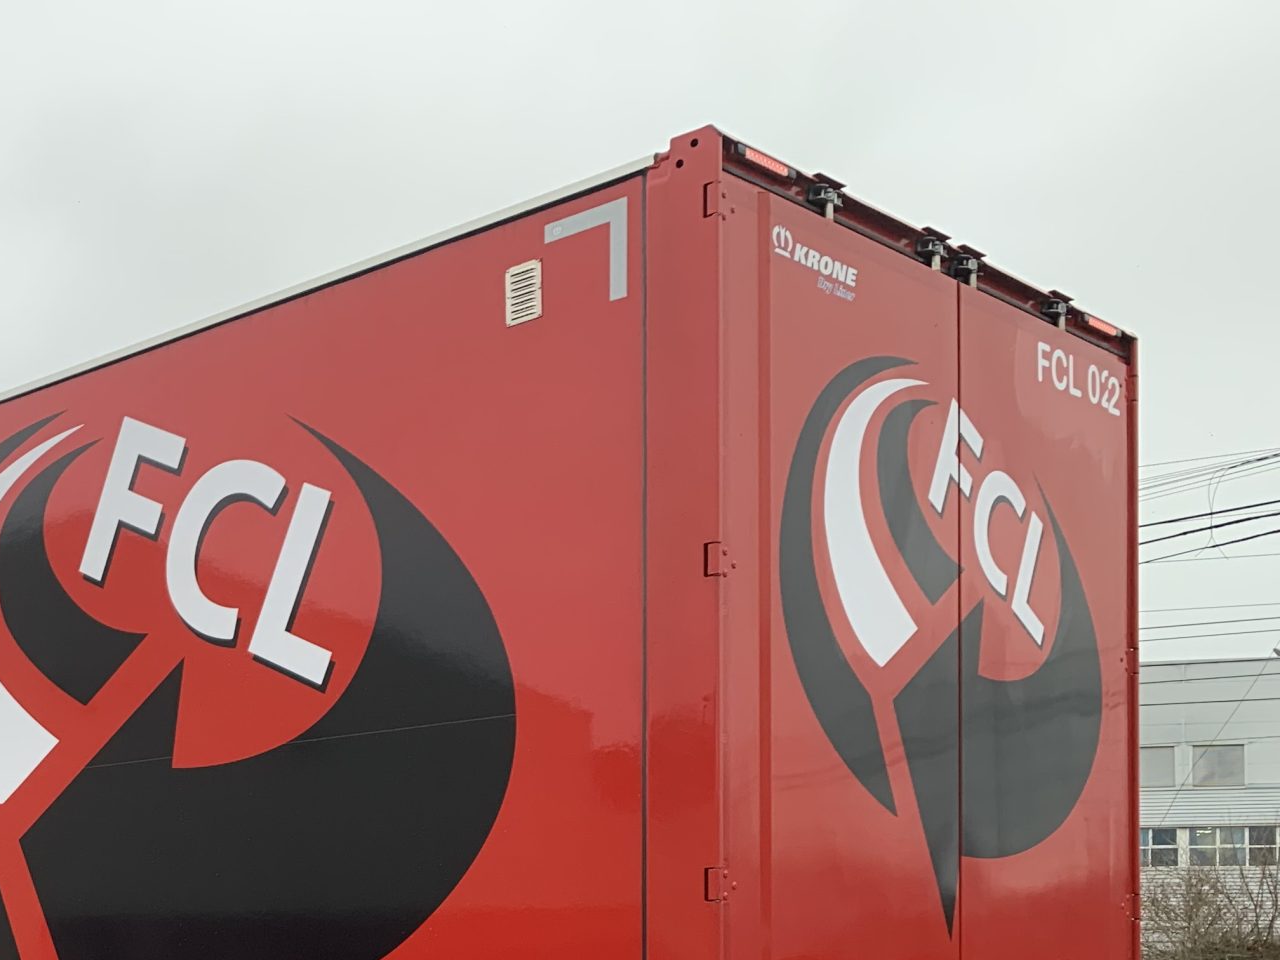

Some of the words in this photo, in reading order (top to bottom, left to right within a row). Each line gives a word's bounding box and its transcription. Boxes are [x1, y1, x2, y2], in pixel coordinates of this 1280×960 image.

[793, 243, 858, 287] KRONE
[1037, 341, 1082, 398] FCL
[78, 415, 335, 692] FCL
[928, 397, 1045, 647] FCL
